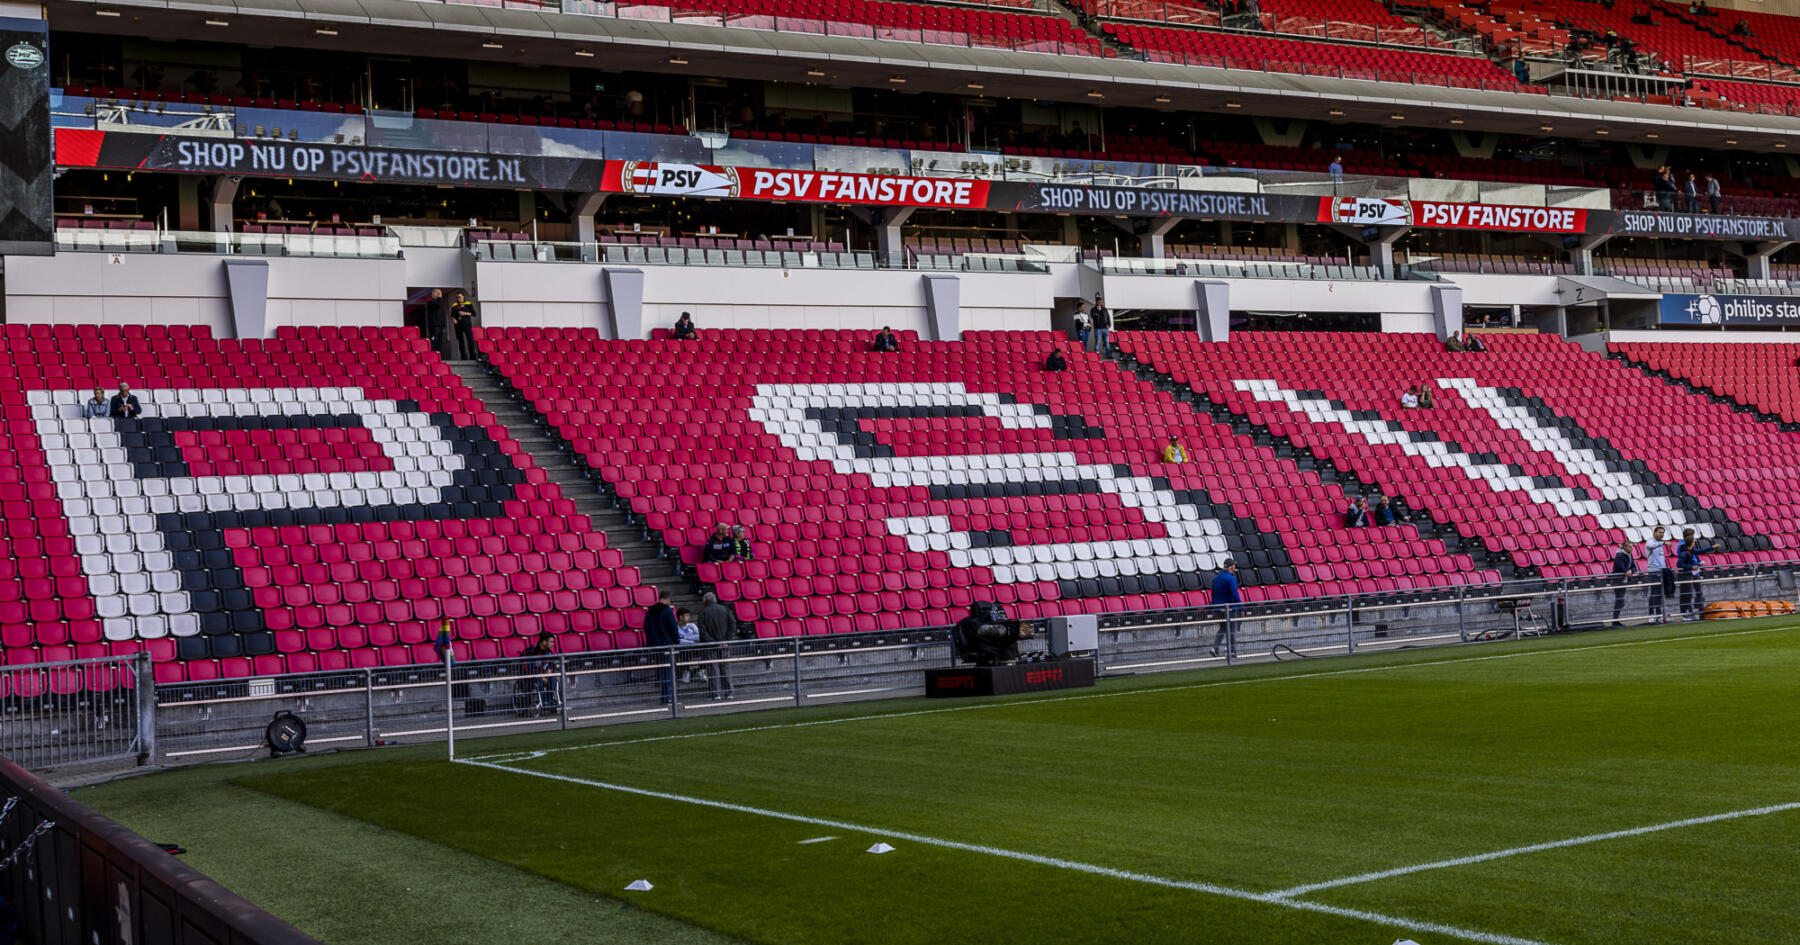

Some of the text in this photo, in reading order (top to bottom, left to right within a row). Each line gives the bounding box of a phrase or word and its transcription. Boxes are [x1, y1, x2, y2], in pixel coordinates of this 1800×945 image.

[178, 141, 526, 182] SHOP NU OP PSVFANSTORE.NL
[661, 169, 702, 188] PSV
[753, 171, 973, 205] PSV FANSTORE
[1040, 187, 1270, 216] SHOP NU OP PSVFANSTORE.NL
[1359, 203, 1387, 218] PSV
[1422, 203, 1575, 230] PSV FANSTORE
[1624, 214, 1788, 238] SHOP NU OP PSVFANSTORE.NL
[1724, 298, 1774, 321] philips
[936, 675, 975, 690] ESPN
[1025, 669, 1063, 685] ESPN
